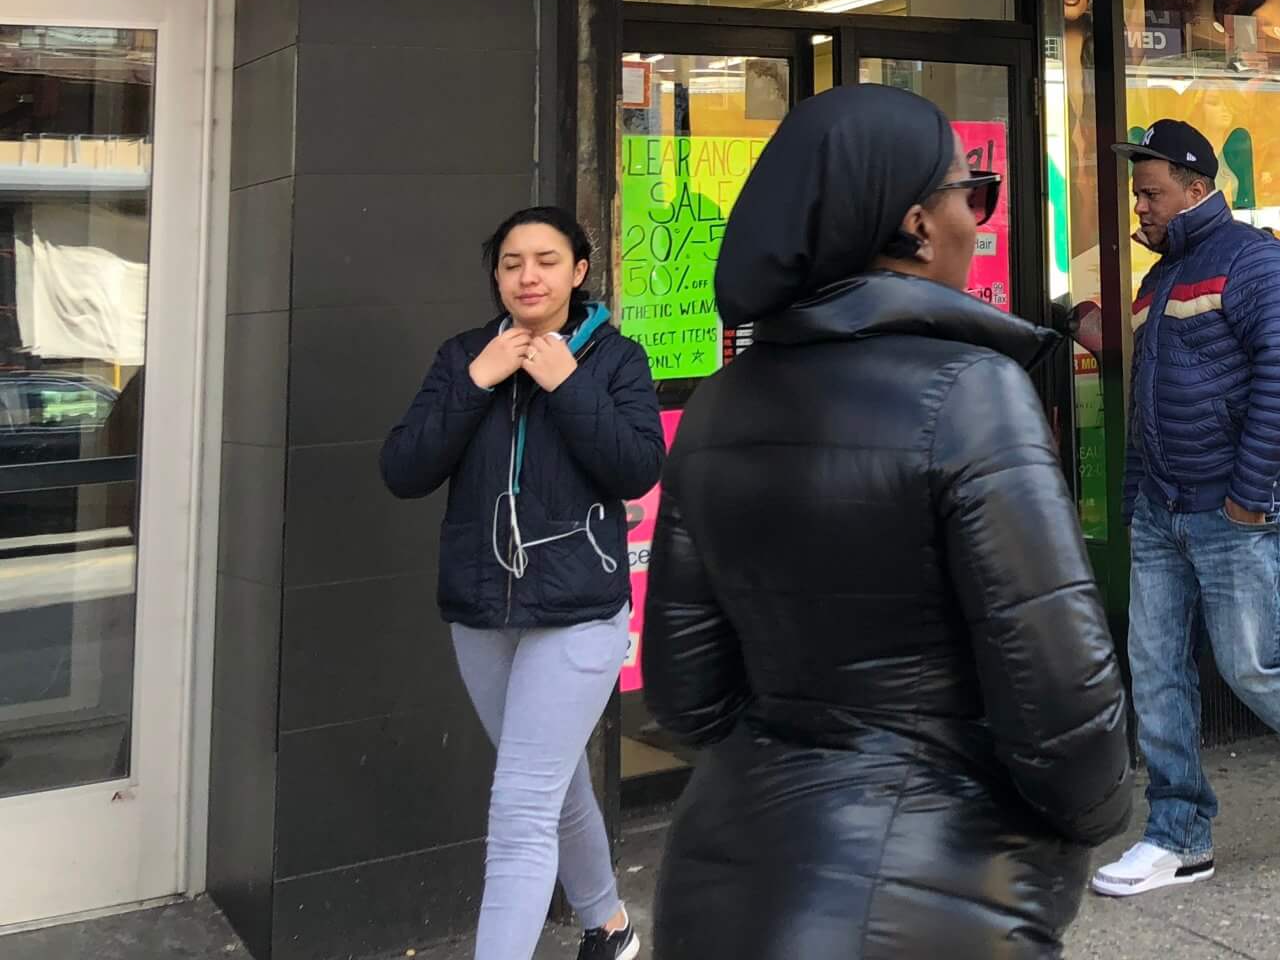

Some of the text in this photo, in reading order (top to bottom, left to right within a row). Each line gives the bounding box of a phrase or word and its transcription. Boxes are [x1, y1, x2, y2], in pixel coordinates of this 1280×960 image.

[622, 138, 768, 178] LEARANCE
[648, 180, 734, 225] SALE
[691, 279, 709, 290] OFF
[680, 298, 718, 317] WEAV
[682, 327, 718, 345] ITEMS
[648, 352, 683, 369] ONLY
